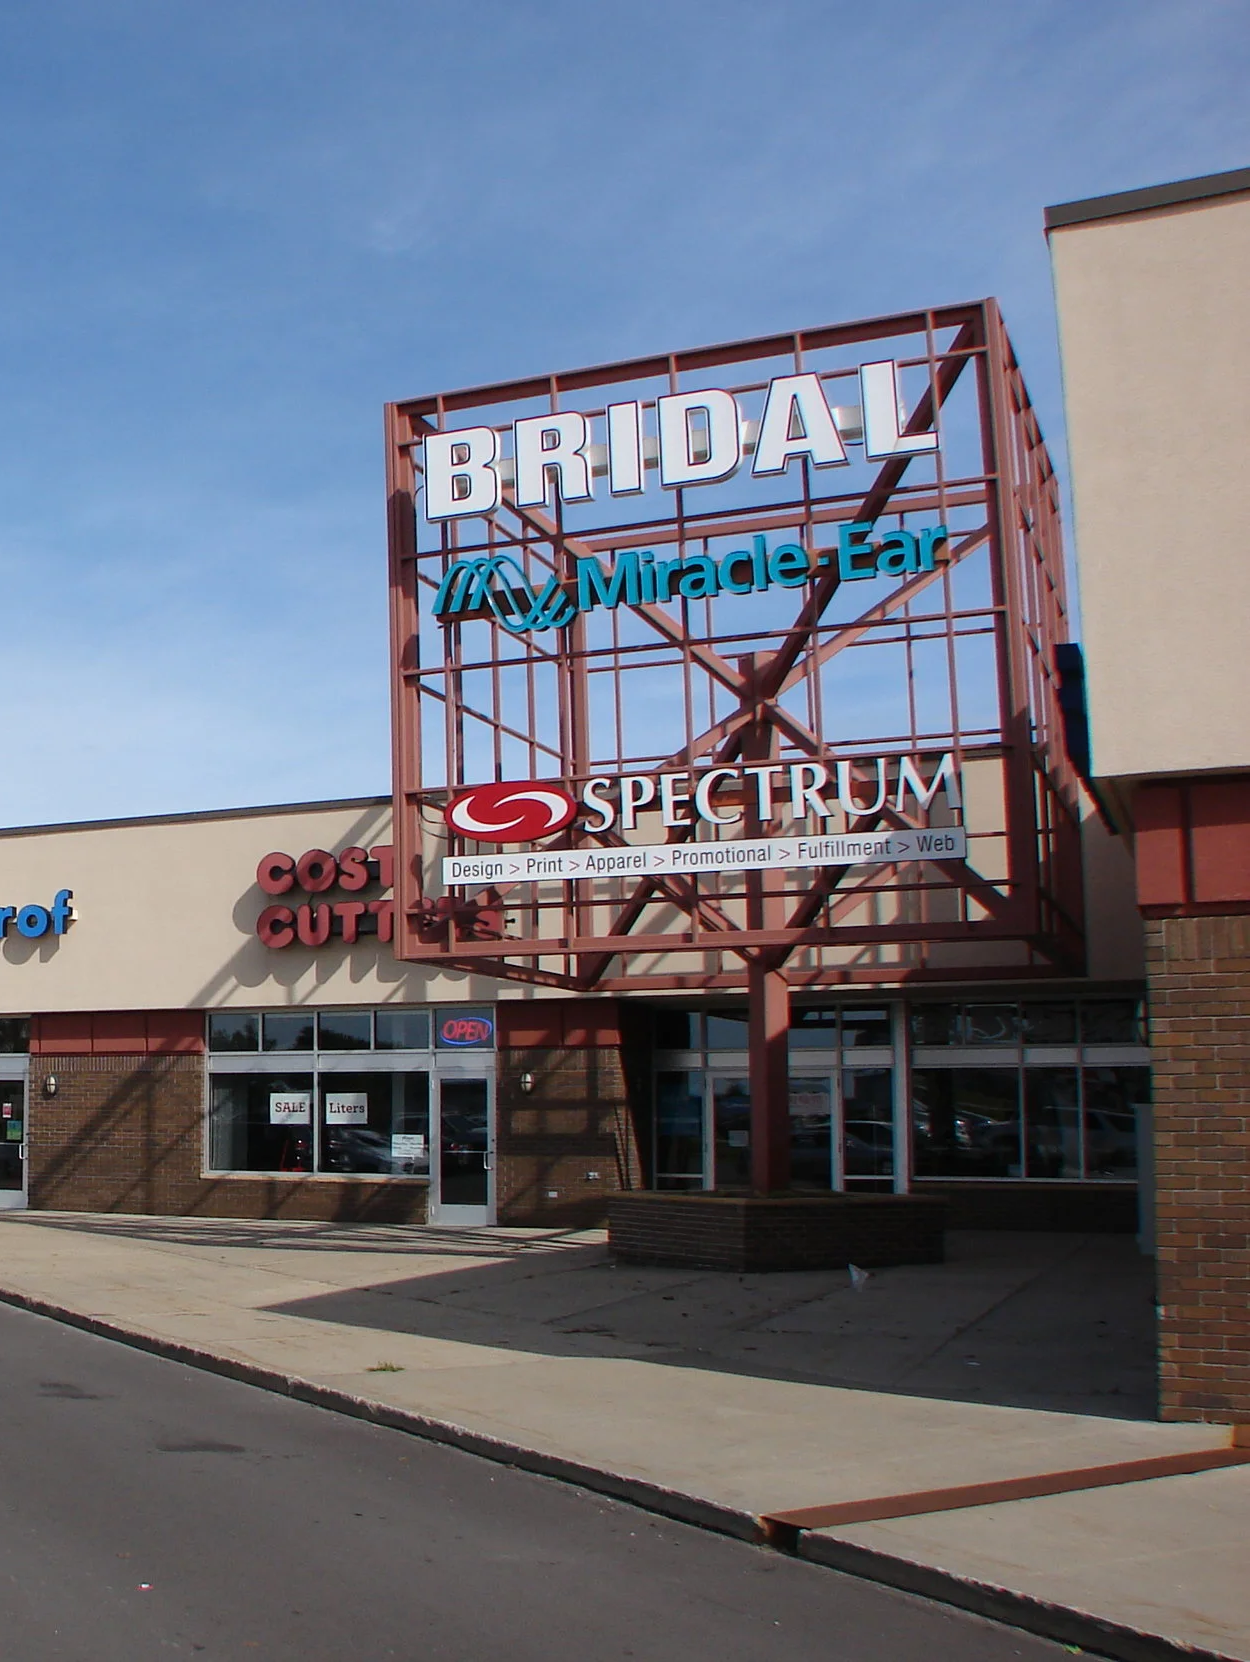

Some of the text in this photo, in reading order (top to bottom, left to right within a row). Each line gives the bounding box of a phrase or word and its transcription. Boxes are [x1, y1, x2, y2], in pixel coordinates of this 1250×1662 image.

[424, 359, 940, 523] BRIDAL
[576, 519, 948, 612] Miracle-Ear
[582, 752, 962, 834] SPECTRUM
[257, 845, 395, 895] COST
[451, 834, 955, 879] Design Print Apparel Promotional Fulfillment Web
[442, 1019, 489, 1041] OPEN
[274, 1101, 306, 1113] SALE
[329, 1102, 365, 1114] Liters
